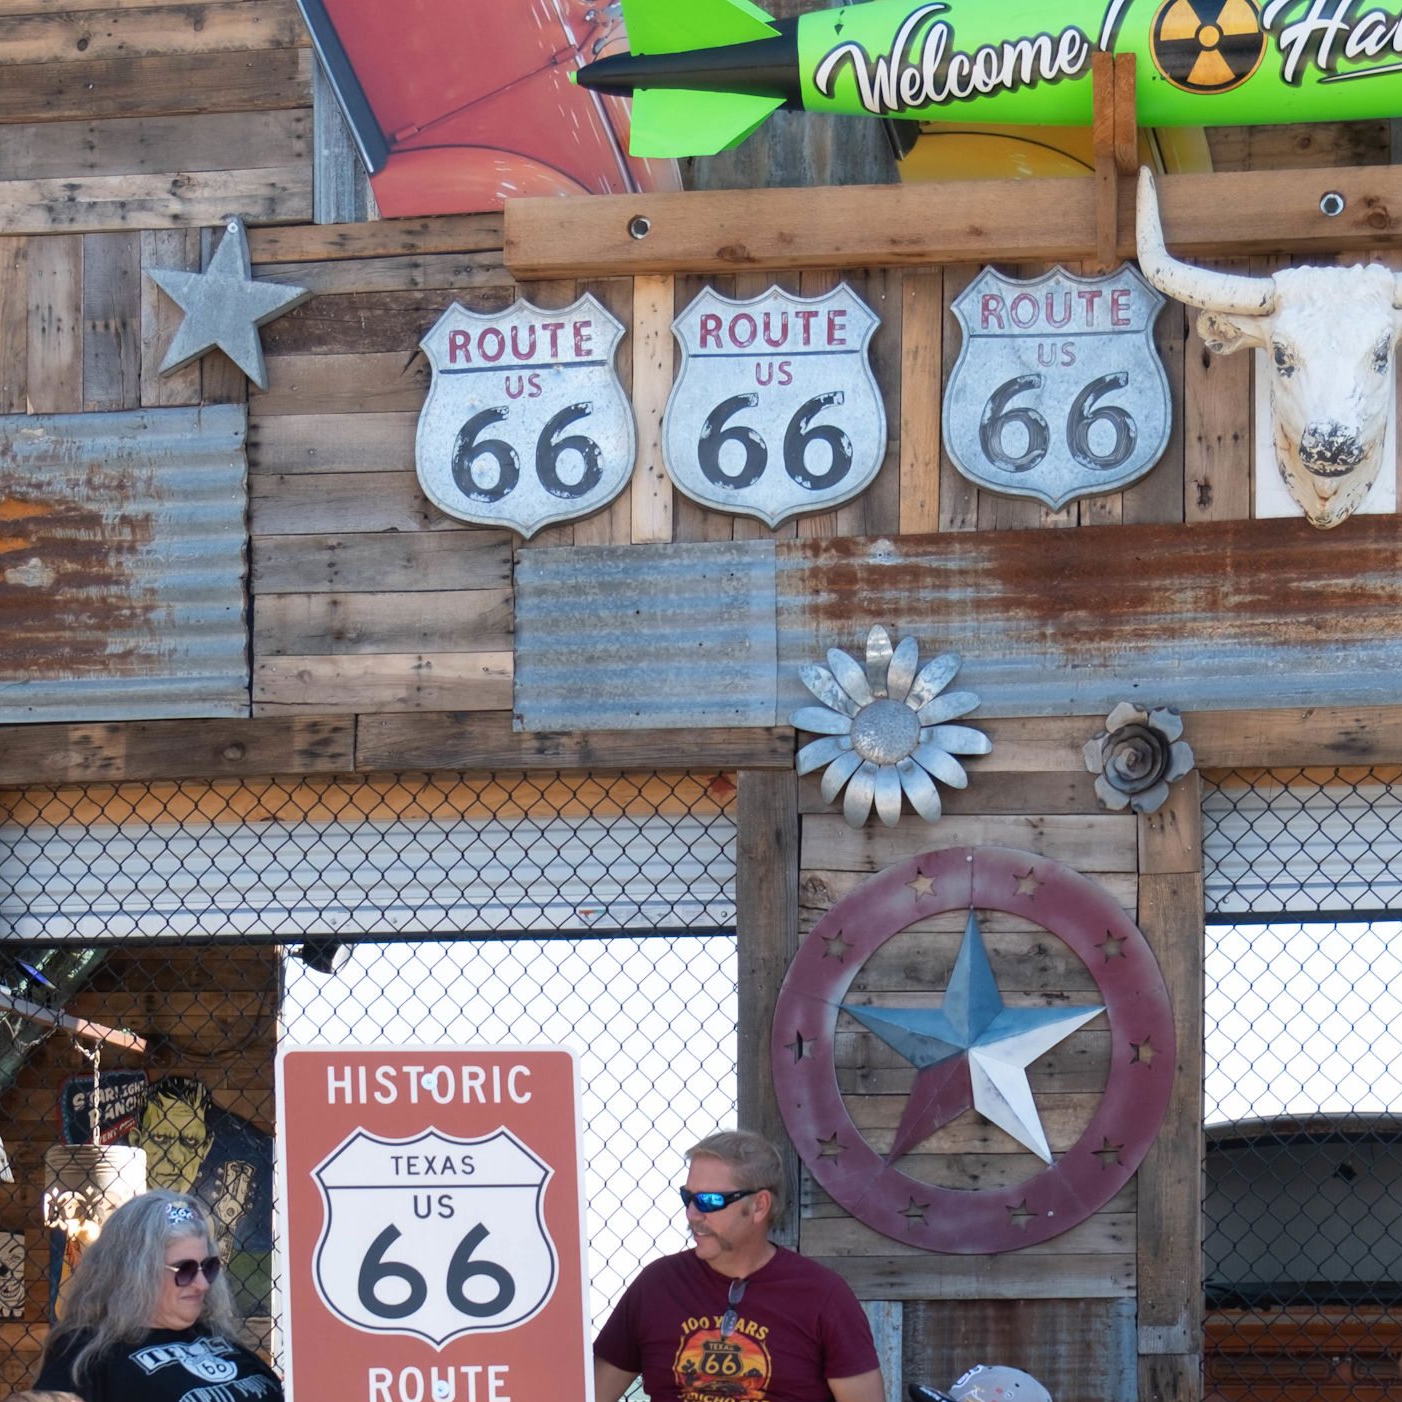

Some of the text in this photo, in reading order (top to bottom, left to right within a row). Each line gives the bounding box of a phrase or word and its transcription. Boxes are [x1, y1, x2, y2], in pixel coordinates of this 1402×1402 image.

[699, 309, 847, 349] ROUTE
[980, 289, 1131, 330] ROUTE
[448, 320, 593, 364] ROUTE
[1037, 341, 1077, 368] US
[505, 373, 543, 400] US
[755, 360, 794, 387] US
[697, 390, 854, 491] 66
[978, 371, 1138, 474] 66
[451, 401, 605, 504] 66
[326, 1065, 533, 1105] HISTORIC
[390, 1155, 476, 1176] TEXAS
[413, 1194, 455, 1219] US
[357, 1222, 516, 1320] 66
[680, 1315, 770, 1341] 100 YARS
[705, 1353, 737, 1375] 66
